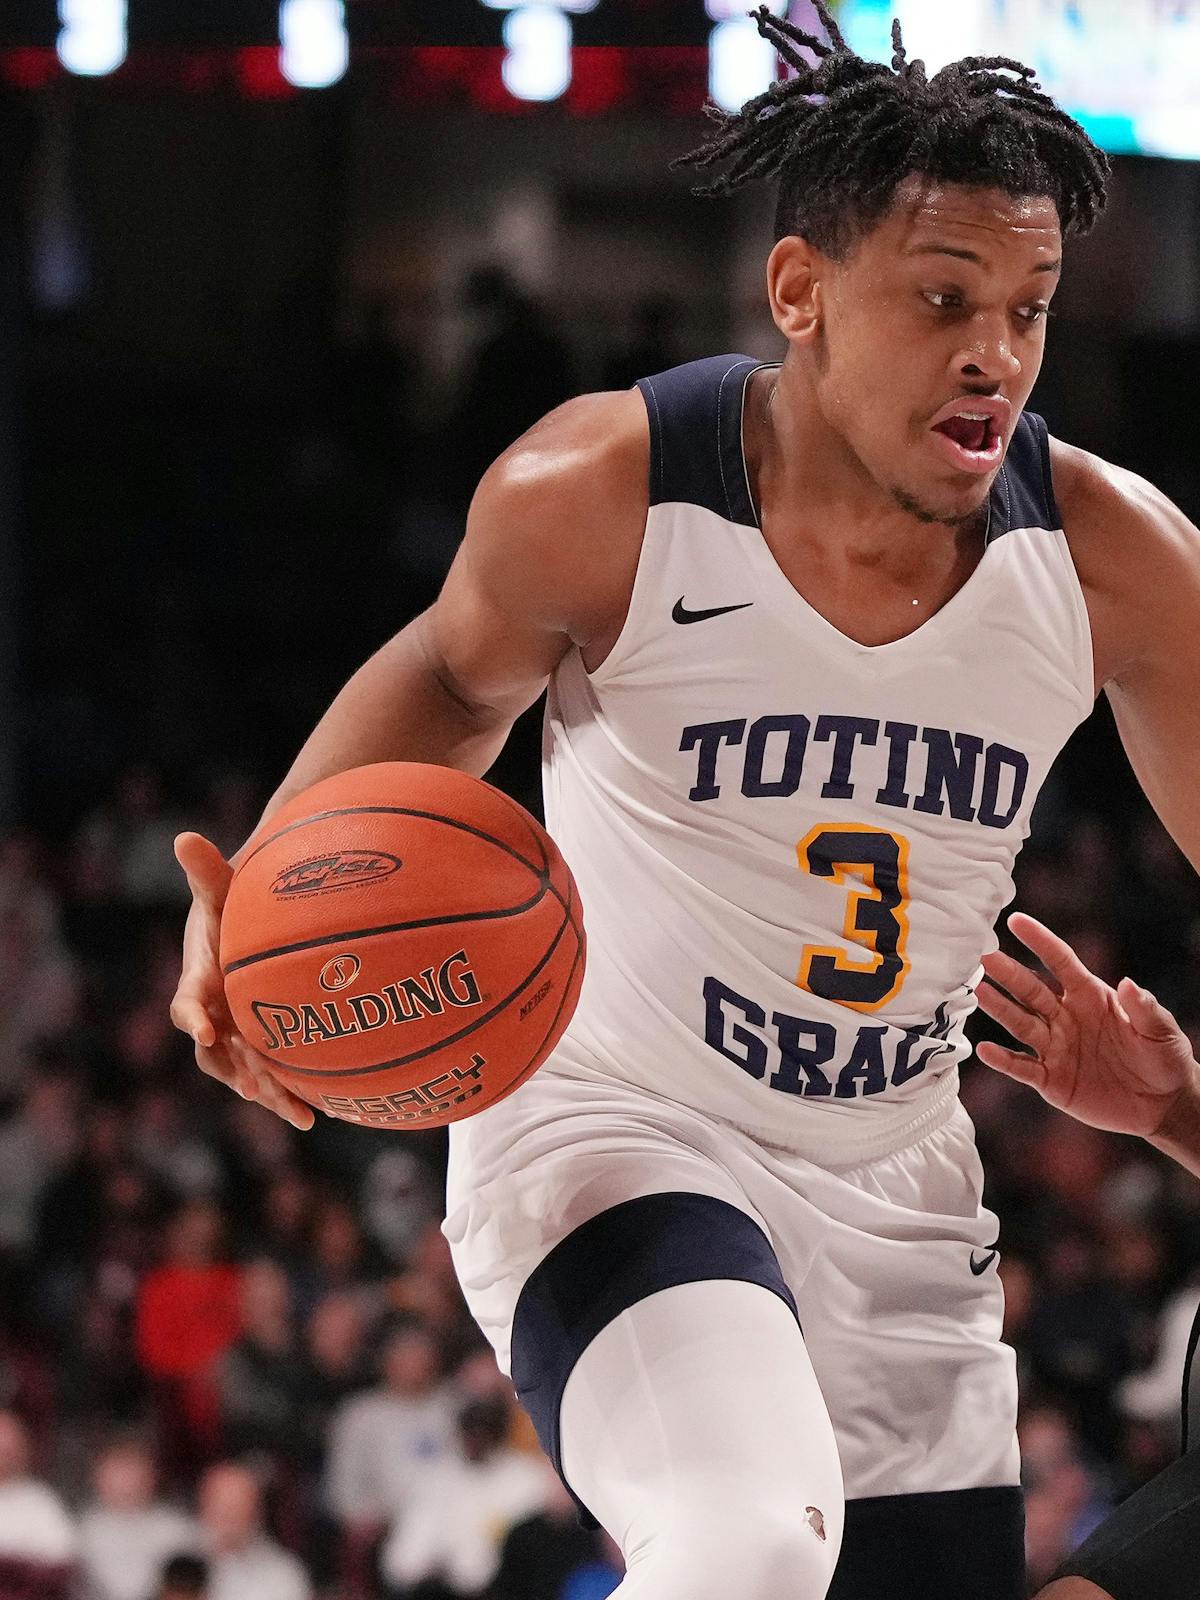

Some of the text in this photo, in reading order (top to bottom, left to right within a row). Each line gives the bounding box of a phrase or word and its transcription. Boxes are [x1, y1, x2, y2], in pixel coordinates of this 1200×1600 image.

[678, 713, 1030, 830] TOTINO
[796, 822, 912, 1013] 3
[251, 948, 483, 1050] SPALDING
[702, 976, 960, 1099] GRAC
[317, 1052, 488, 1114] EGACY
